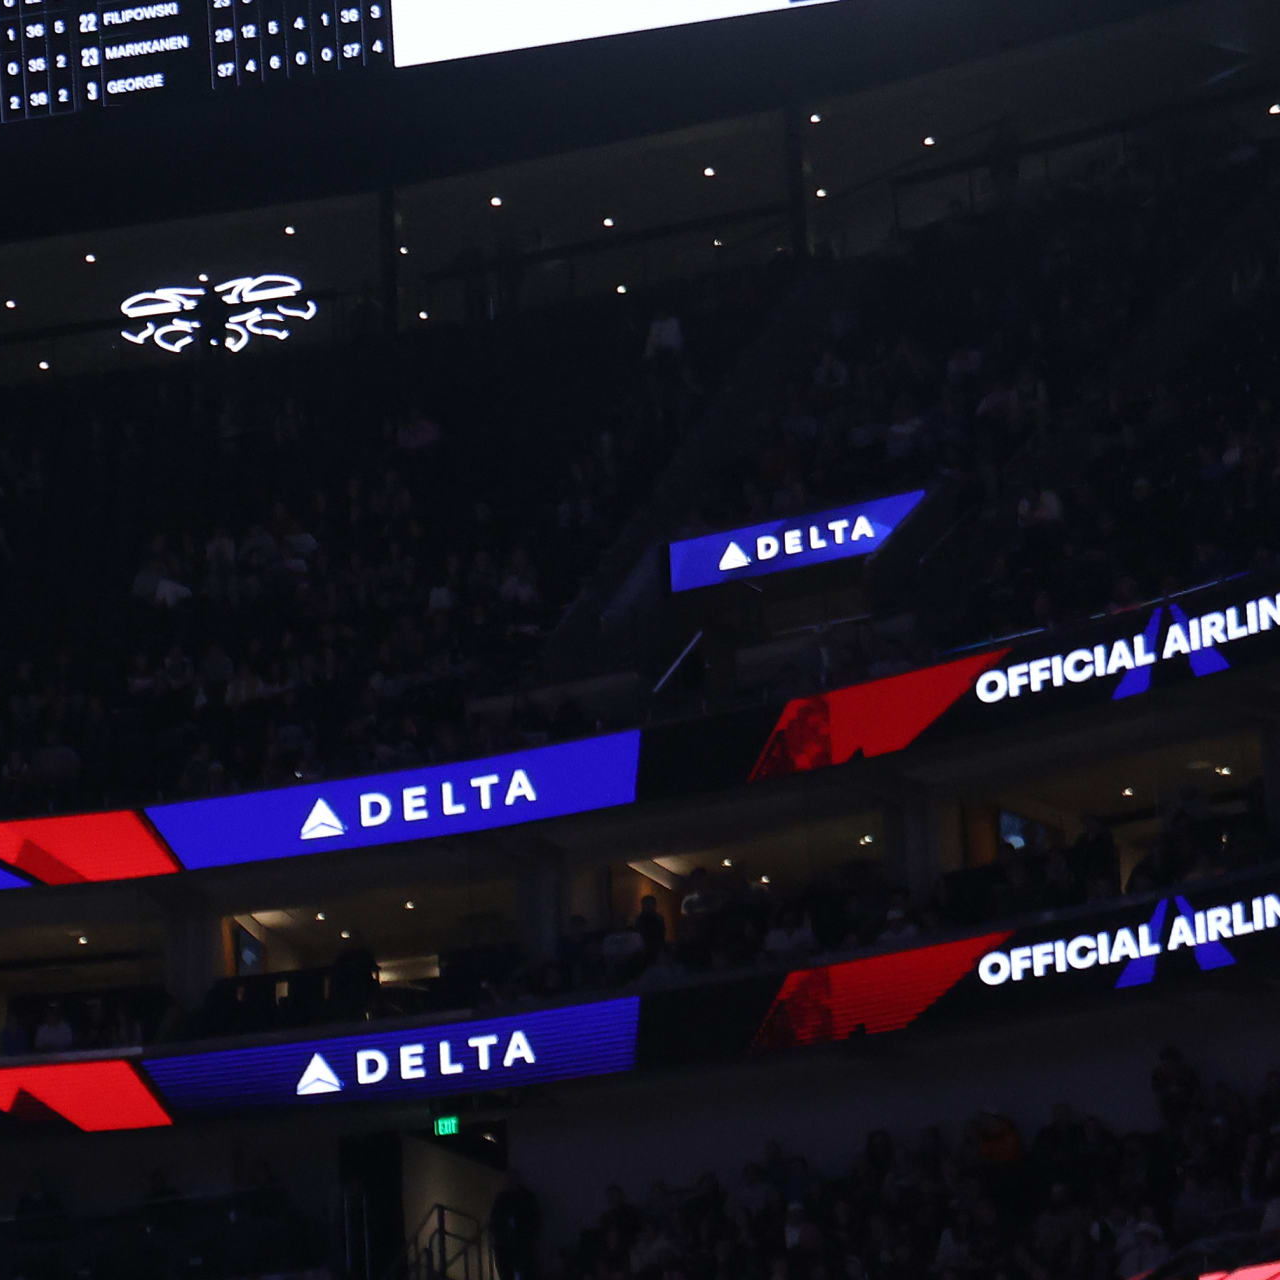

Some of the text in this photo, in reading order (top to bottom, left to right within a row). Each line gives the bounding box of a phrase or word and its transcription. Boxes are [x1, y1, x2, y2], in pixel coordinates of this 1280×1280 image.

[102, 2, 178, 26] FILIPOWSKI
[80, 47, 99, 67] 23
[104, 35, 189, 60] MARKKANEN
[106, 73, 164, 94] GEORGE
[756, 515, 875, 561] DELTA
[975, 634, 1156, 703] OFFICIAL
[359, 769, 537, 828] DELTA
[978, 924, 1161, 986] OFFICIAL
[356, 1030, 536, 1085] DELTA
